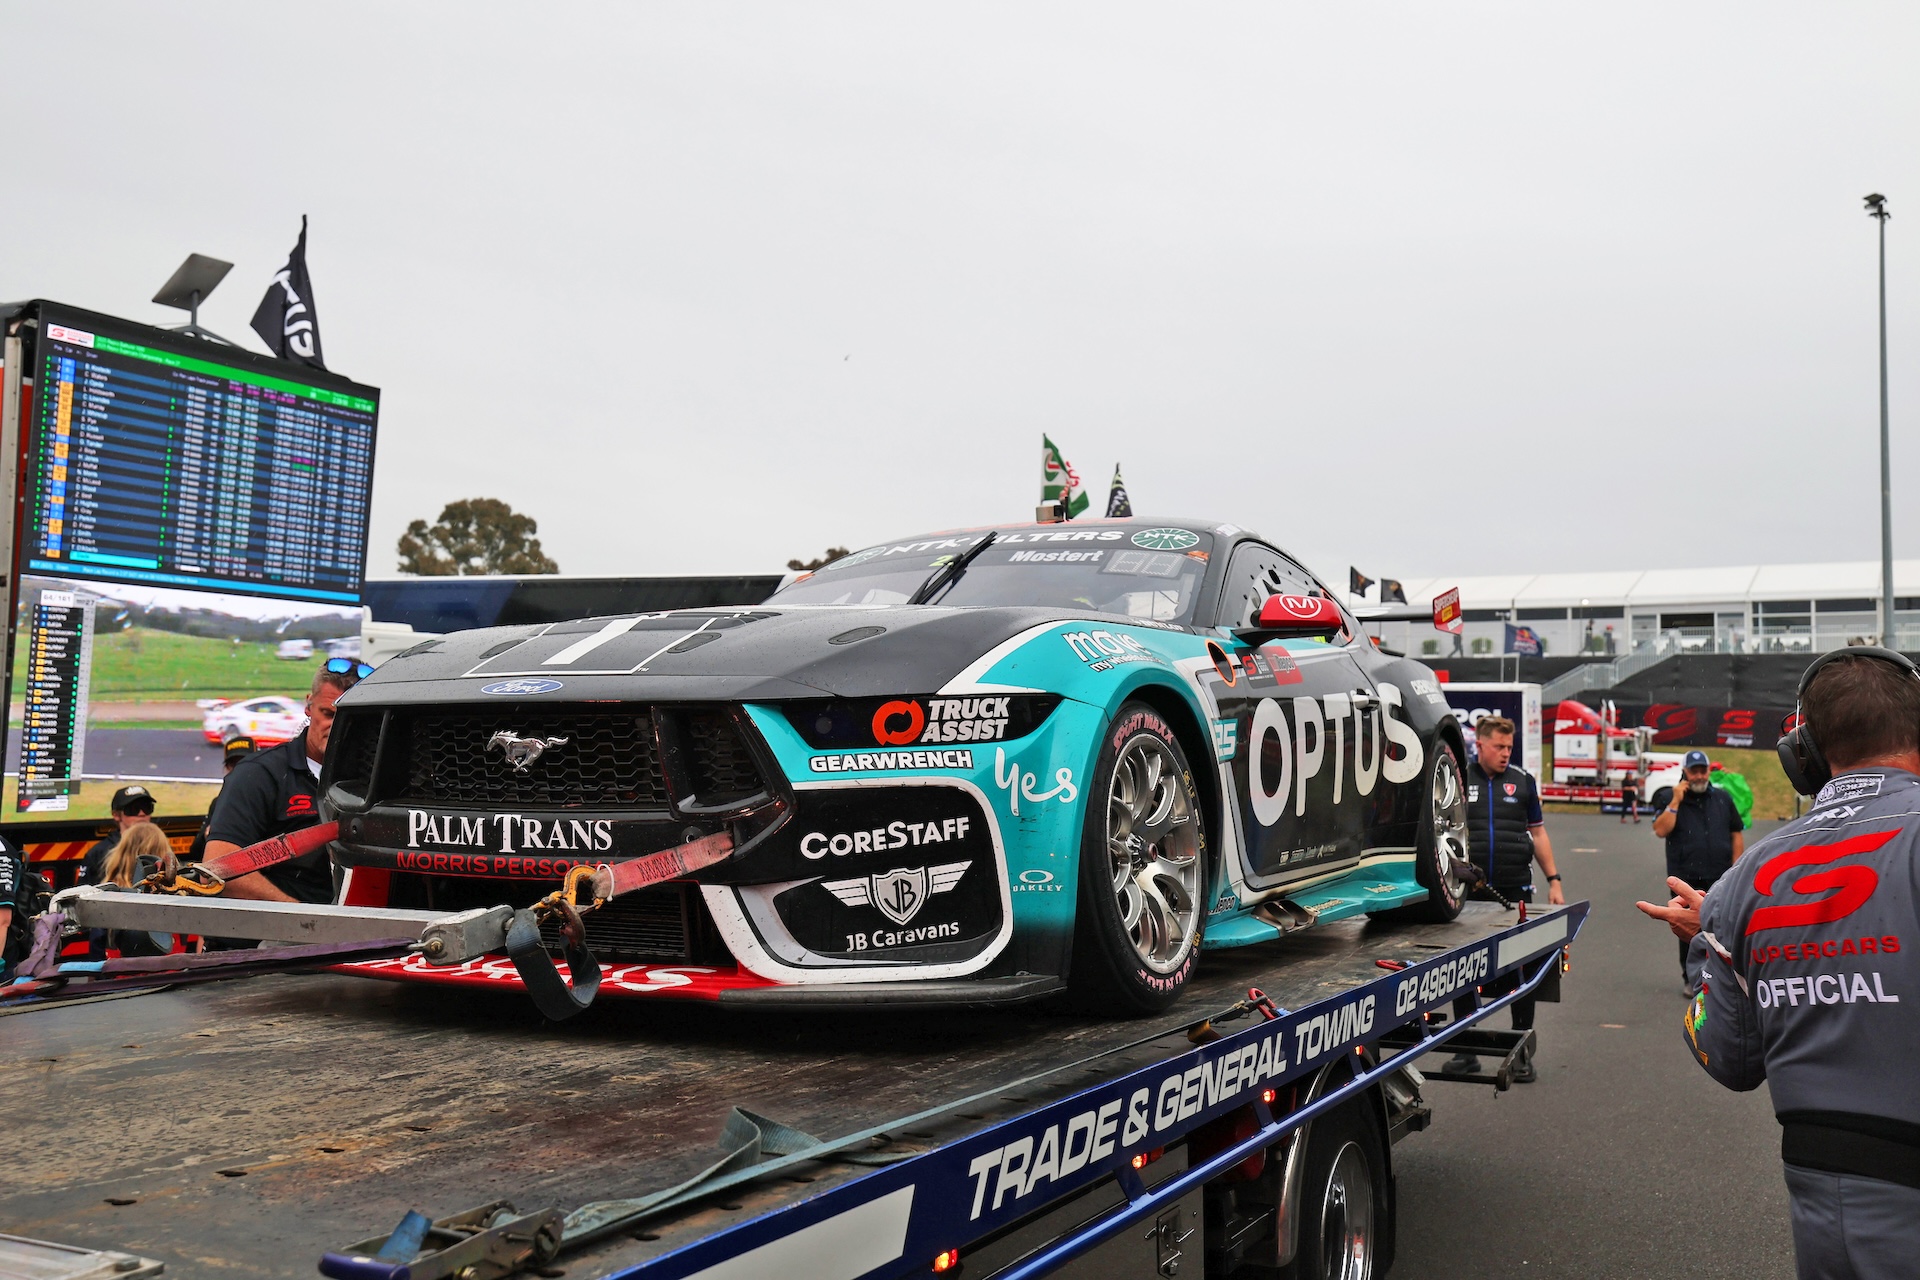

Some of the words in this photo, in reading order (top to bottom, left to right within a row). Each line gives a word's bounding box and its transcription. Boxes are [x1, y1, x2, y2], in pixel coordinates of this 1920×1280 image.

[884, 537, 970, 556] NTK
[1143, 532, 1188, 542] NTK
[1008, 550, 1104, 564] Mostert
[1061, 629, 1152, 663] move
[927, 697, 1011, 720] TRUCK
[920, 717, 1009, 743] ASSIST
[810, 751, 973, 772] GEARWRENCH
[1248, 682, 1425, 828] OPTUS
[407, 809, 486, 848] PALM
[493, 813, 613, 853] TRANS
[396, 851, 490, 873] MORRIS
[493, 855, 615, 878] PERSO
[1011, 884, 1064, 892] OAKLEY
[846, 933, 869, 953] JB
[875, 922, 960, 948] Caravans
[1749, 934, 1901, 967] UPERCARS
[1395, 976, 1418, 1017] 02
[1418, 960, 1457, 1008] 4960
[1456, 946, 1489, 992] 2475
[1757, 972, 1901, 1009] OFFICIAL
[967, 1111, 1117, 1222] TRADE
[1121, 1093, 1150, 1148] &
[1153, 1039, 1289, 1132] GENERAL
[1293, 994, 1376, 1063] TOWING
